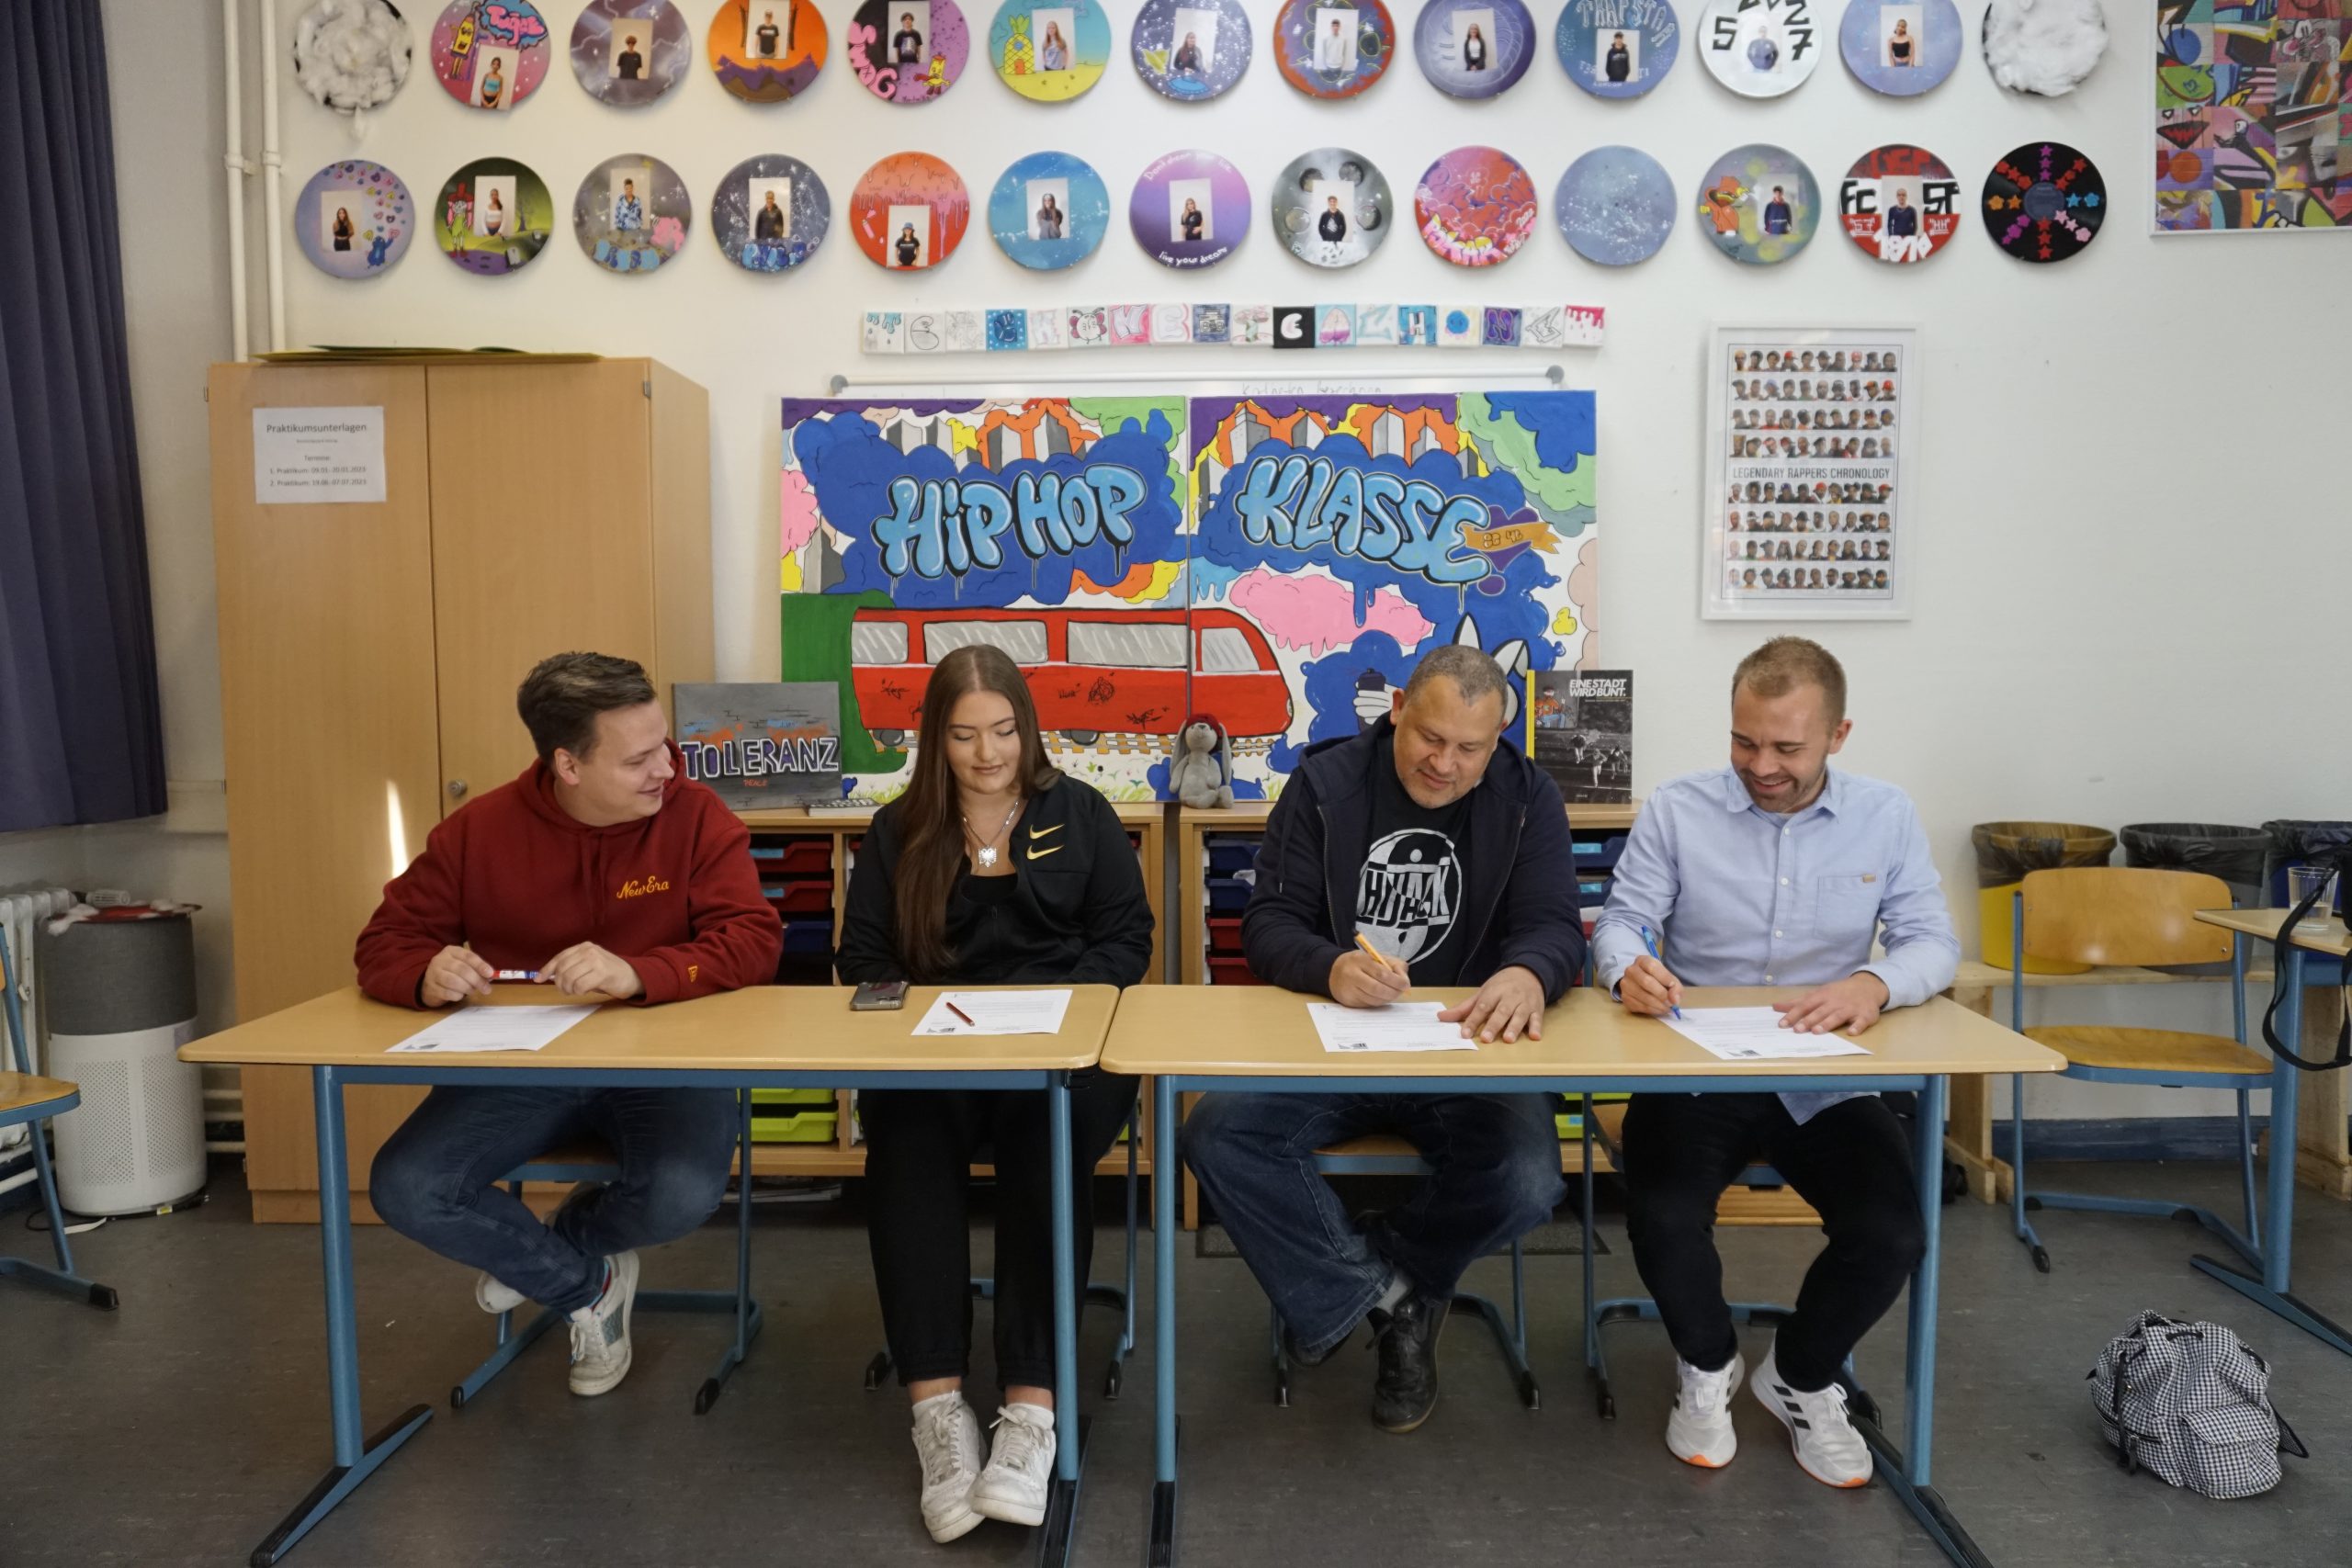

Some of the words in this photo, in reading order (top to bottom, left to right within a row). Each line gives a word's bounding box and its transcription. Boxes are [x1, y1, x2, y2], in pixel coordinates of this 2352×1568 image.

[1176, 257, 1198, 266] your
[266, 423, 367, 433] Praktikumsunterlagen
[1733, 467, 1785, 479] LEGENDARY
[1787, 467, 1827, 479] RAPPERS
[1830, 467, 1891, 479] CHRONOLOGY
[1010, 463, 1148, 557] HOP
[1234, 455, 1491, 584] KLASSE
[679, 738, 838, 780] TOLERANZ
[616, 880, 645, 899] New
[646, 875, 670, 894] Era
